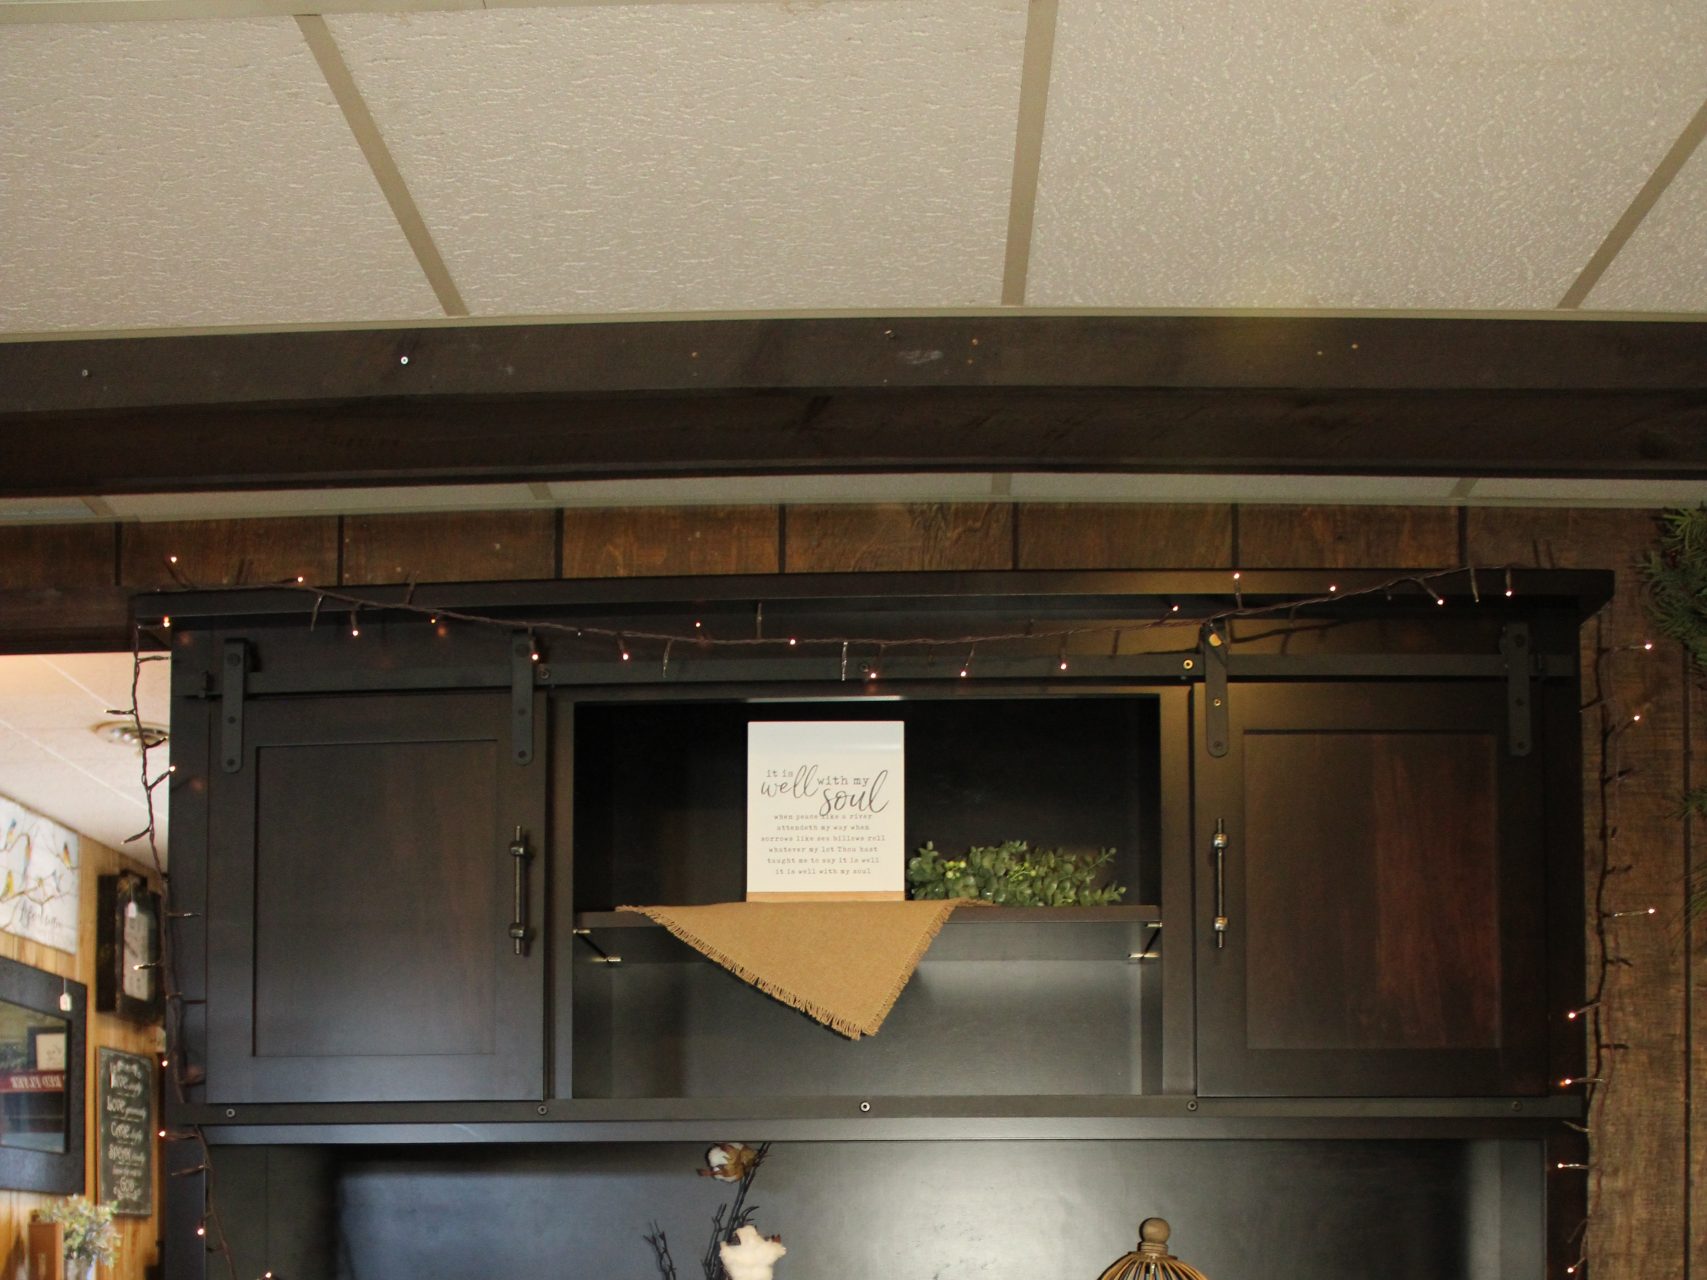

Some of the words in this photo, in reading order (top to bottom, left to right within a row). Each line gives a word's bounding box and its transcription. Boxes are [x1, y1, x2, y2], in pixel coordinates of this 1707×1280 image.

[761, 765, 819, 798] well
[782, 770, 793, 778] is
[817, 776, 848, 785] with
[853, 778, 870, 787] my
[819, 770, 889, 816] soul
